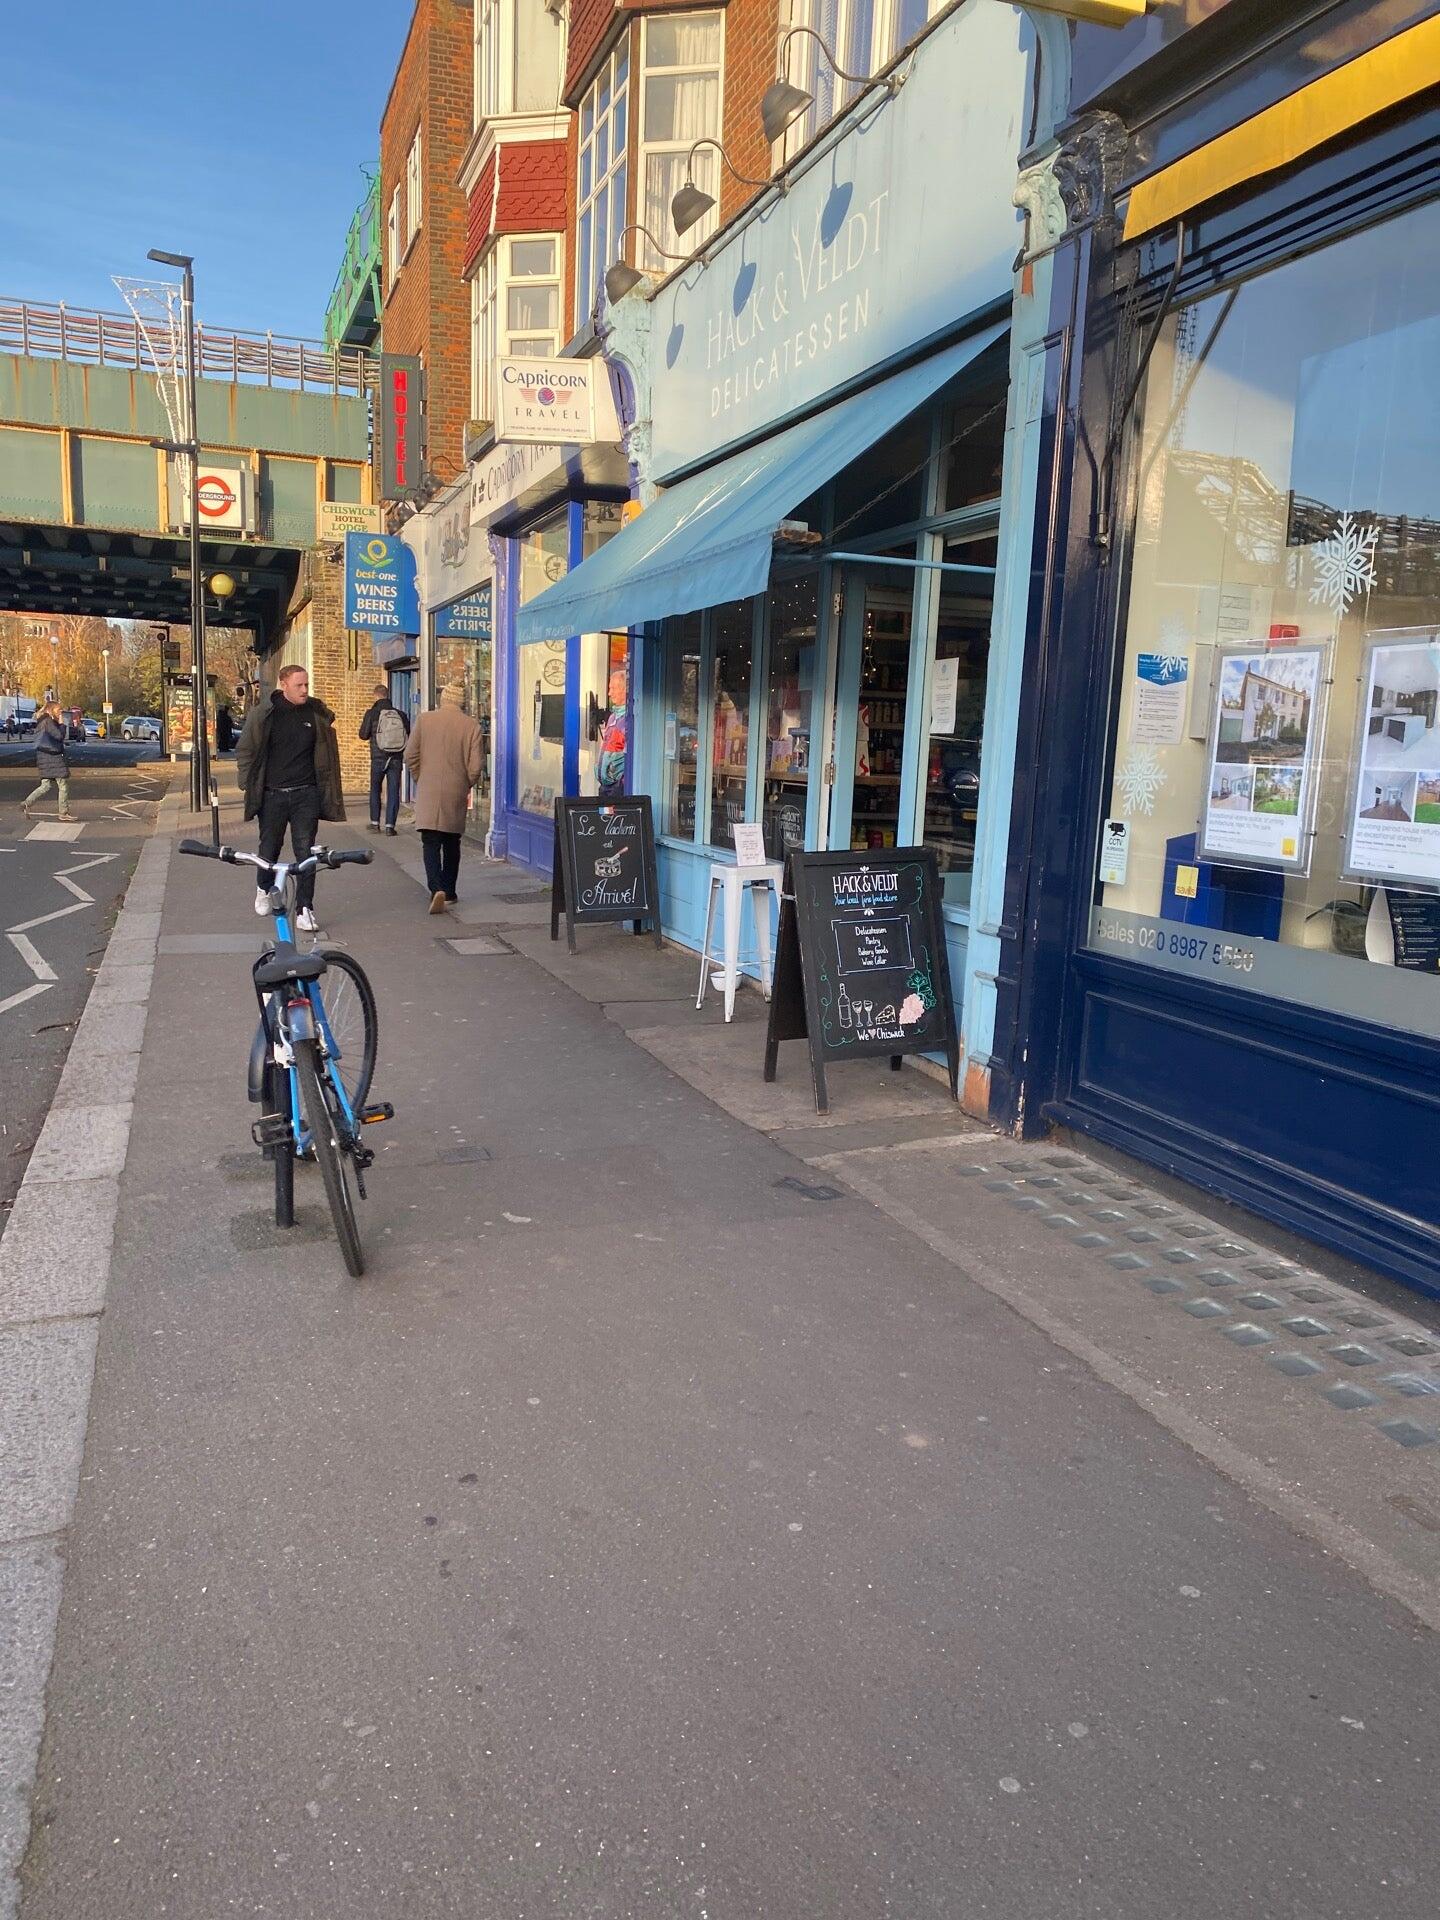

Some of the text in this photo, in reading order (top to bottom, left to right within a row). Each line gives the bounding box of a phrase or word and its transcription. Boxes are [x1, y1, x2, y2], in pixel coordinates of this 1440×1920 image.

[706, 190, 889, 370] HACK & VELDT
[711, 288, 869, 417] DELICATESSEN
[515, 407, 581, 420] TRAVEL
[393, 370, 408, 485] HOTEL
[322, 505, 377, 516] CHISWICK
[335, 515, 365, 524] HOTEL
[332, 523, 368, 533] LODGE
[354, 583, 398, 598] WINES
[356, 598, 395, 612] BEERS
[352, 612, 400, 626] SPIRITS
[577, 814, 597, 836] Le
[1109, 837, 1123, 846] CCTV
[865, 936, 881, 947] Pantry
[1098, 919, 1135, 944] Sales
[1138, 928, 1165, 950] 020
[1169, 934, 1208, 960] 8987
[857, 1028, 906, 1041] We Chiswick
